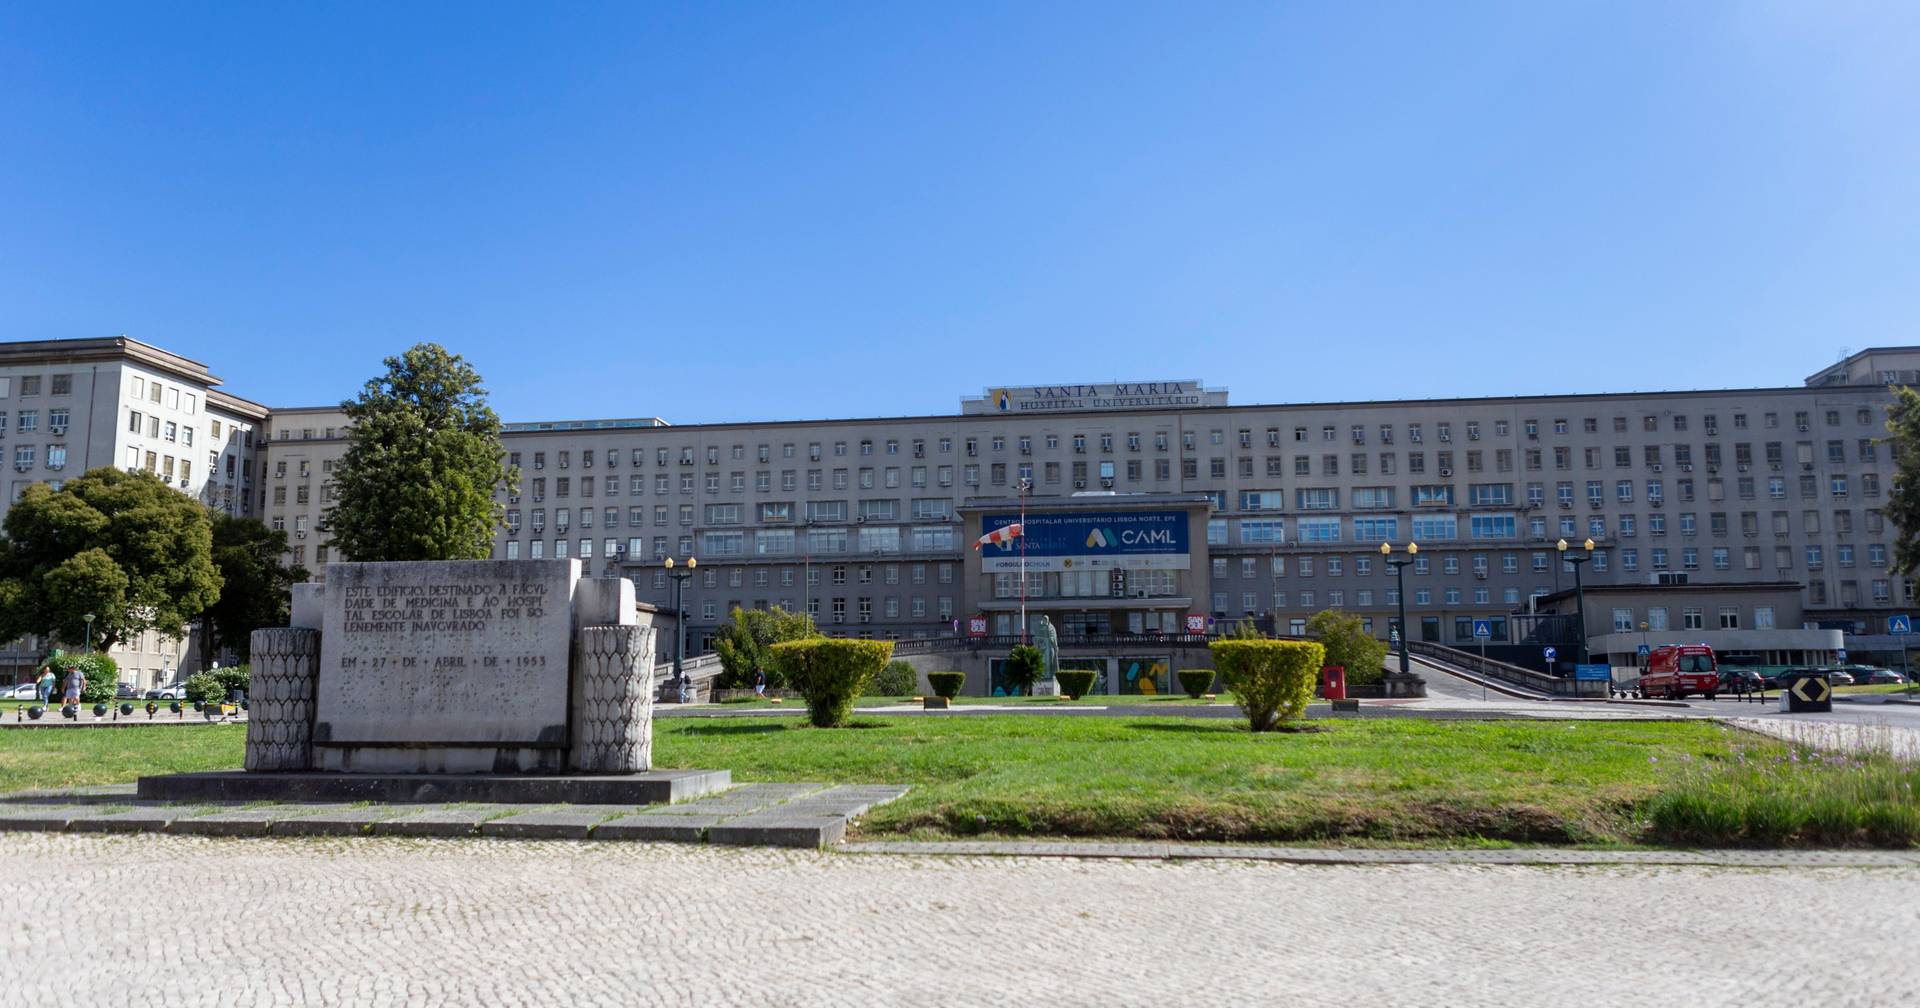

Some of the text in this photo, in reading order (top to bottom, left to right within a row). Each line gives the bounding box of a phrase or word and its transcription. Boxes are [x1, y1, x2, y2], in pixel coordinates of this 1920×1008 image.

[1034, 382, 1183, 398] SANTA MARIA
[1020, 400, 1084, 409] HOSPITAL
[1121, 529, 1176, 545] CAML
[345, 586, 371, 597] ESTE
[428, 584, 492, 596] DESTINADO
[344, 598, 375, 609] DADE
[382, 598, 398, 609] DE
[406, 597, 459, 608] MEDICINA
[467, 597, 473, 608] E
[483, 596, 499, 608] AO
[344, 610, 365, 621] TAL
[372, 609, 424, 621] ESCOLAR
[431, 609, 446, 620] DE
[453, 608, 493, 619] LISBOA
[501, 608, 519, 620] FOI
[343, 621, 407, 633] LENEMENTE
[341, 655, 546, 669] EM 27 DE ABRIL DE 1953
